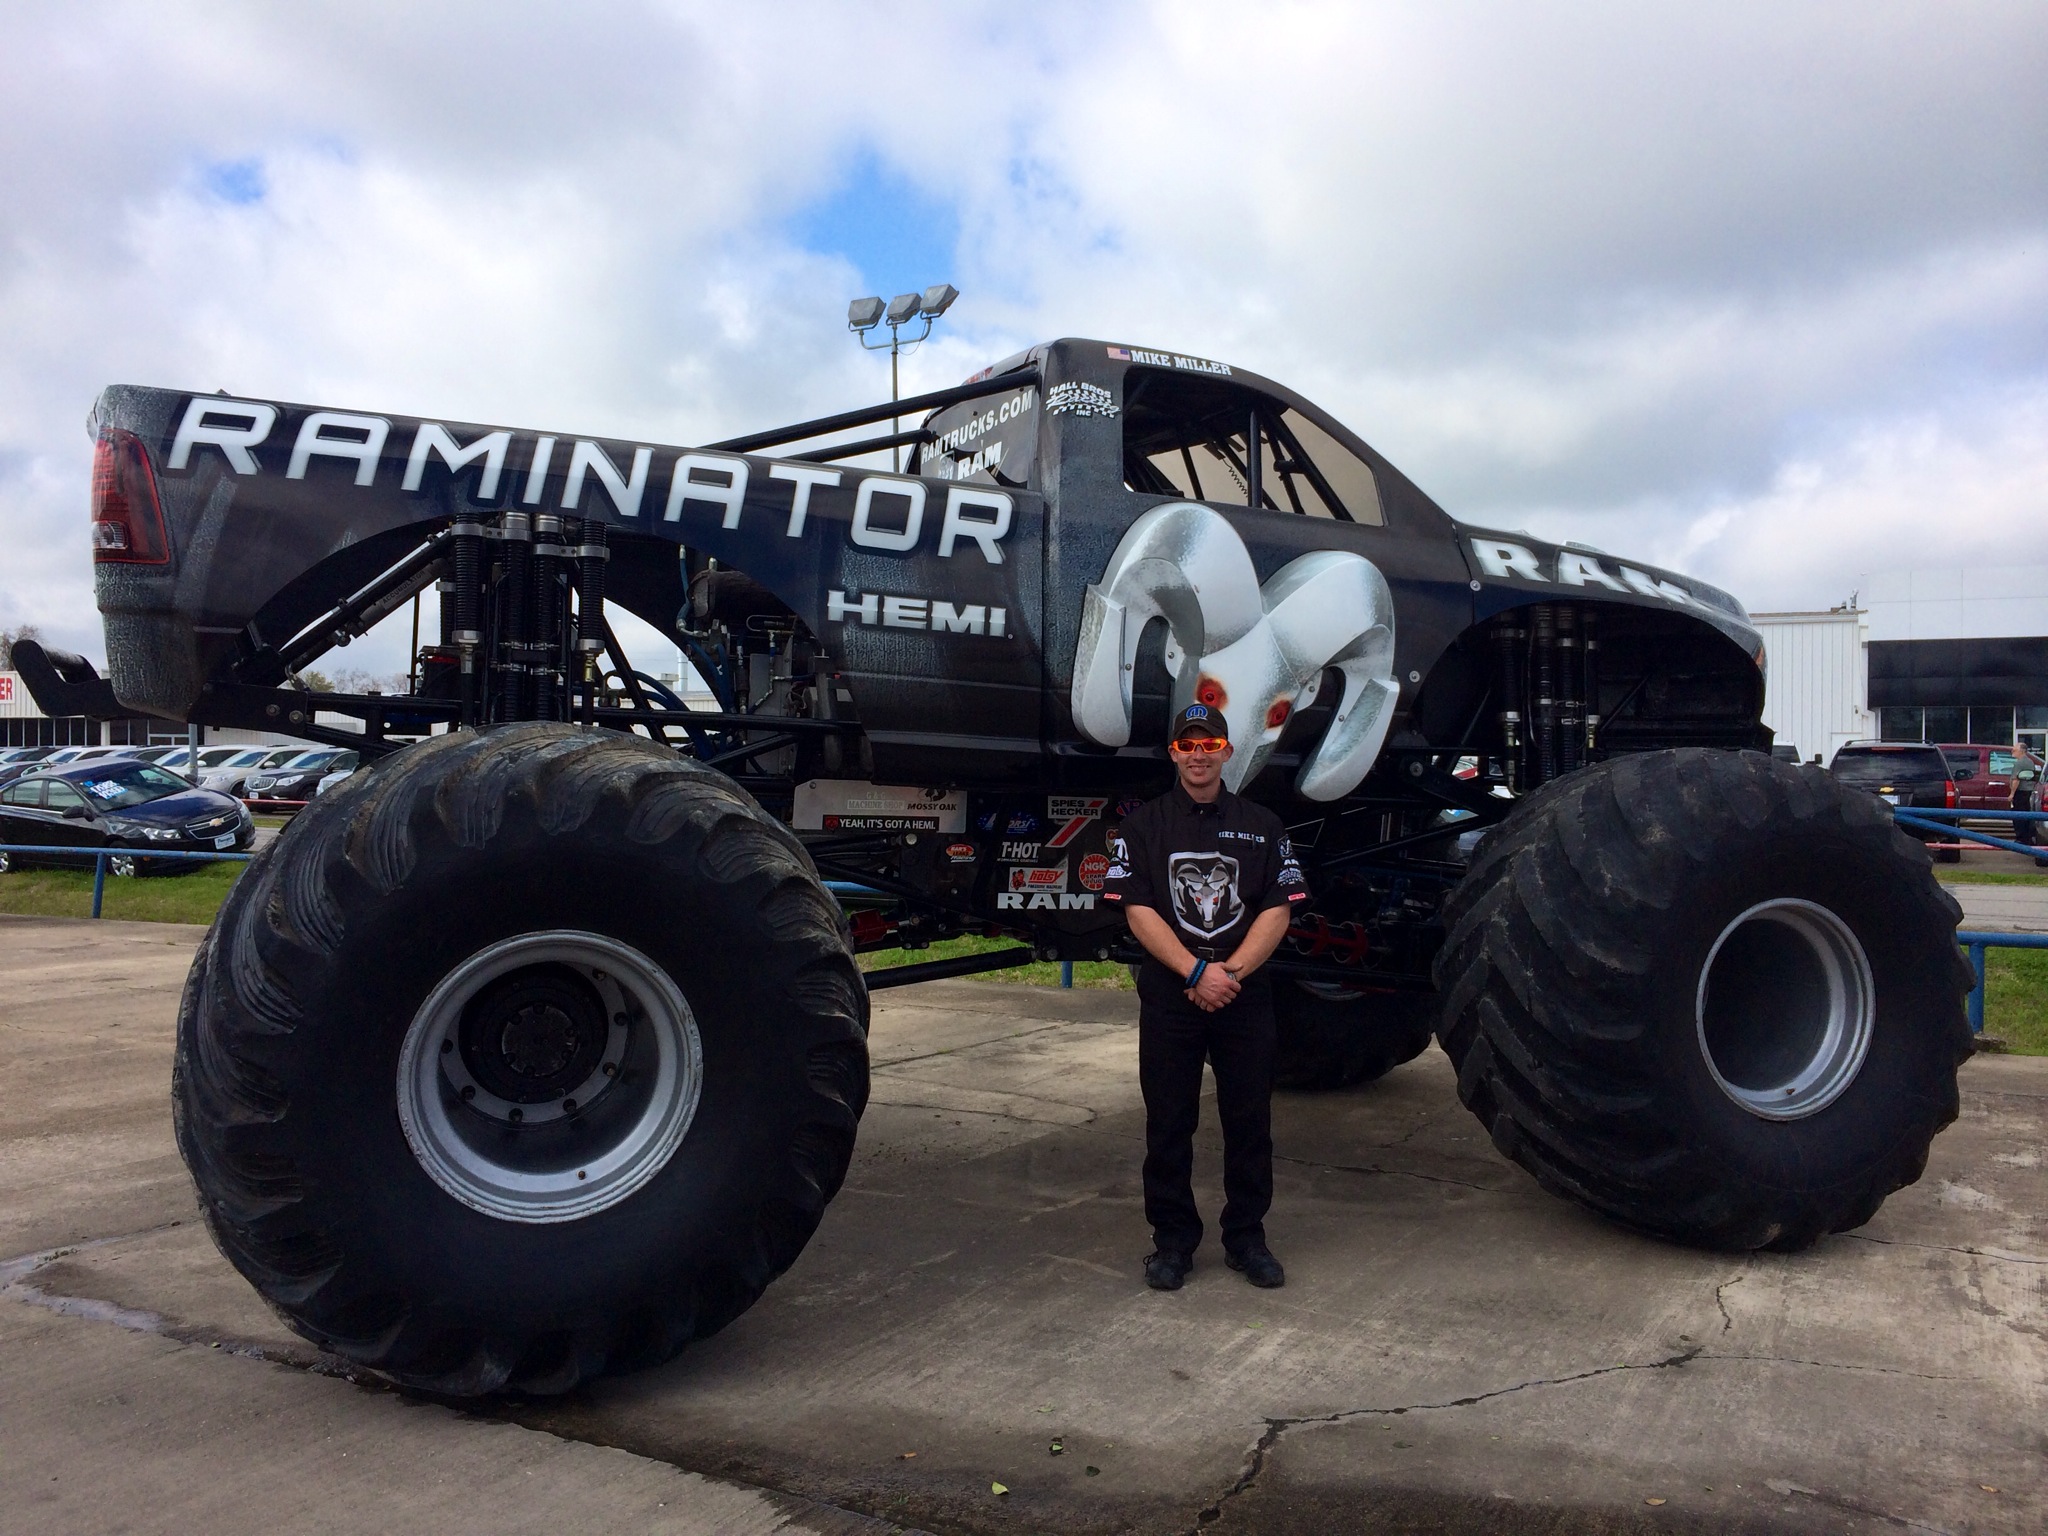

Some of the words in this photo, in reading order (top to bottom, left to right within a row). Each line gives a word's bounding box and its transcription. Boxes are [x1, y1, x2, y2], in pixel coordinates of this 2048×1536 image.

[1131, 350, 1171, 367] MIKE
[1173, 356, 1232, 375] MILLER
[1049, 381, 1078, 395] HALL
[1081, 382, 1111, 398] BROS
[1076, 409, 1091, 417] INC
[921, 389, 1033, 465] RAMTRUCKS.COM
[958, 441, 1002, 481] RAM
[167, 397, 1014, 564] RAMINATOR
[1470, 538, 1694, 604] RAM
[907, 803, 938, 811] MOSSY
[939, 803, 957, 811] OAK
[1051, 800, 1085, 808] SPIES
[1051, 807, 1099, 817] HECKER
[839, 818, 866, 829] YEAH,
[867, 818, 883, 828] IT'S
[885, 819, 903, 829] GOT
[904, 820, 911, 829] A
[912, 820, 936, 830] HEMI.
[1002, 842, 1041, 859] T-HOT
[1084, 862, 1106, 871] NGK
[998, 893, 1094, 909] RAM
